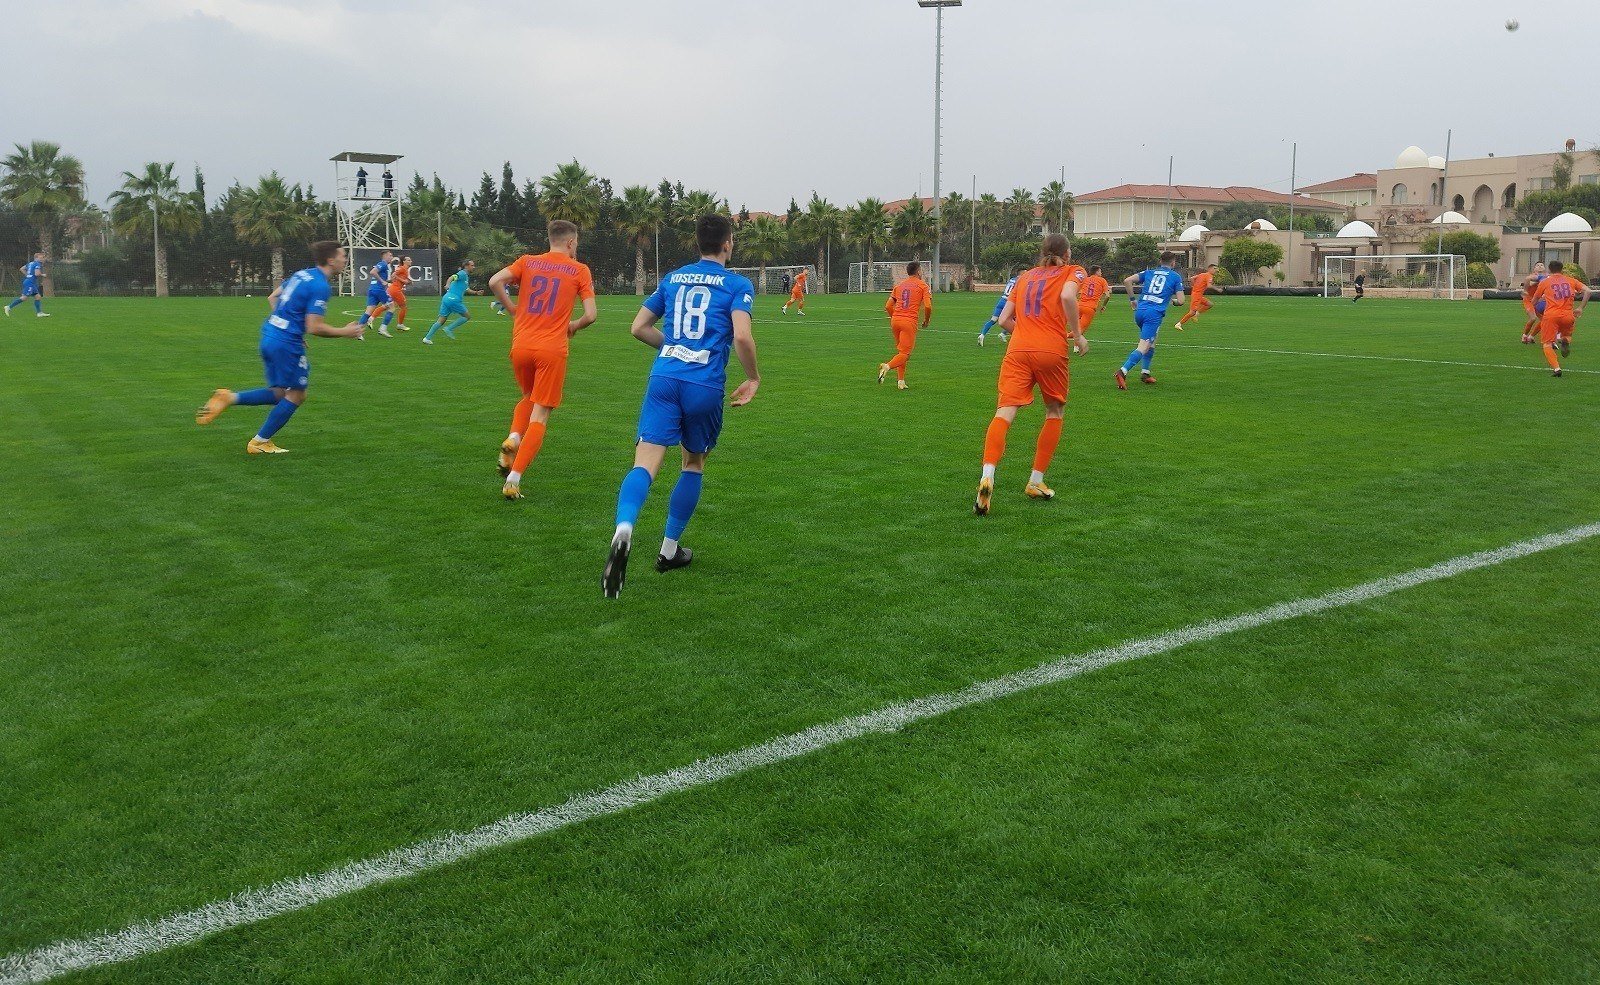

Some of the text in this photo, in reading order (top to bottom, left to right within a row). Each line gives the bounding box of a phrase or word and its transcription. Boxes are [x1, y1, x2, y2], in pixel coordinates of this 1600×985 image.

[528, 275, 561, 315] 21
[1025, 279, 1047, 316] 11
[1148, 274, 1167, 295] 19
[1551, 282, 1571, 300] 38
[673, 285, 712, 340] 18
